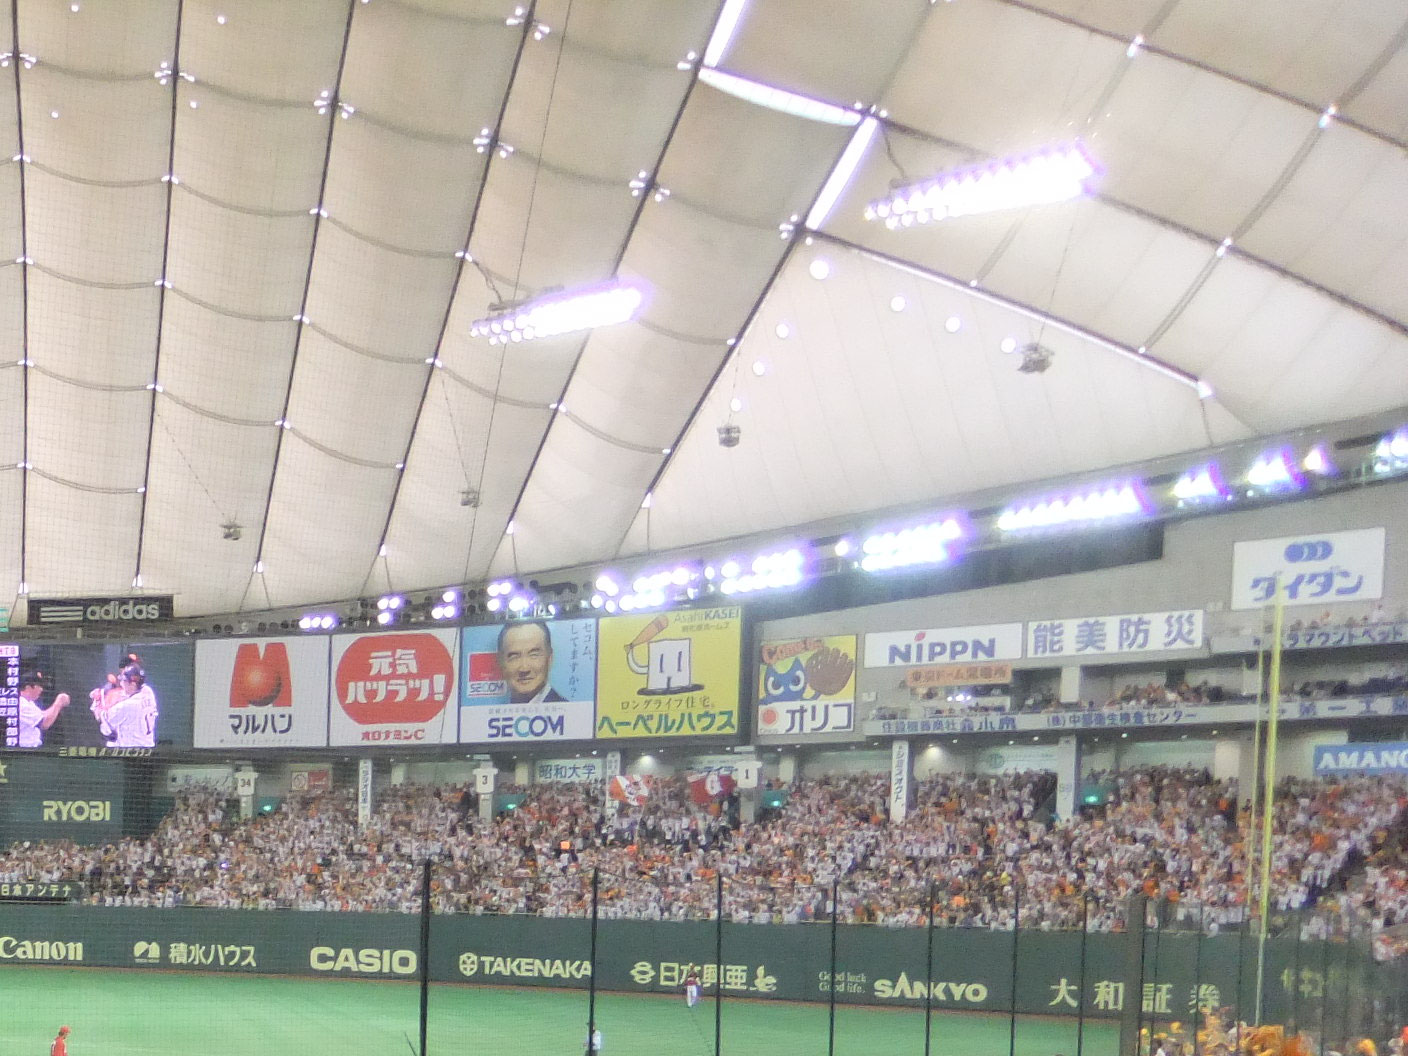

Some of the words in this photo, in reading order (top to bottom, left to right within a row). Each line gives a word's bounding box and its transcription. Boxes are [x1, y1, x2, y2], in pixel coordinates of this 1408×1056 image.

[87, 601, 159, 620] adidas
[1033, 612, 1196, 655] 能美防災
[888, 631, 996, 665] NIPPN
[368, 648, 419, 676] 元気
[469, 681, 505, 694] SECOM
[228, 714, 292, 734] マルハン
[488, 715, 564, 738] SECOM
[598, 710, 736, 735] ヘーベルハウス
[785, 703, 854, 734] オリコ
[361, 729, 426, 741] オロナミンC
[539, 763, 596, 781] 昭和大学
[42, 800, 111, 821] RYOBI
[1, 884, 72, 896] 日本アンテナ
[169, 942, 257, 967] 積水ハウス
[309, 946, 417, 974] CASIO
[480, 956, 591, 979] TAKENAKA
[874, 971, 988, 1002] SANKYO
